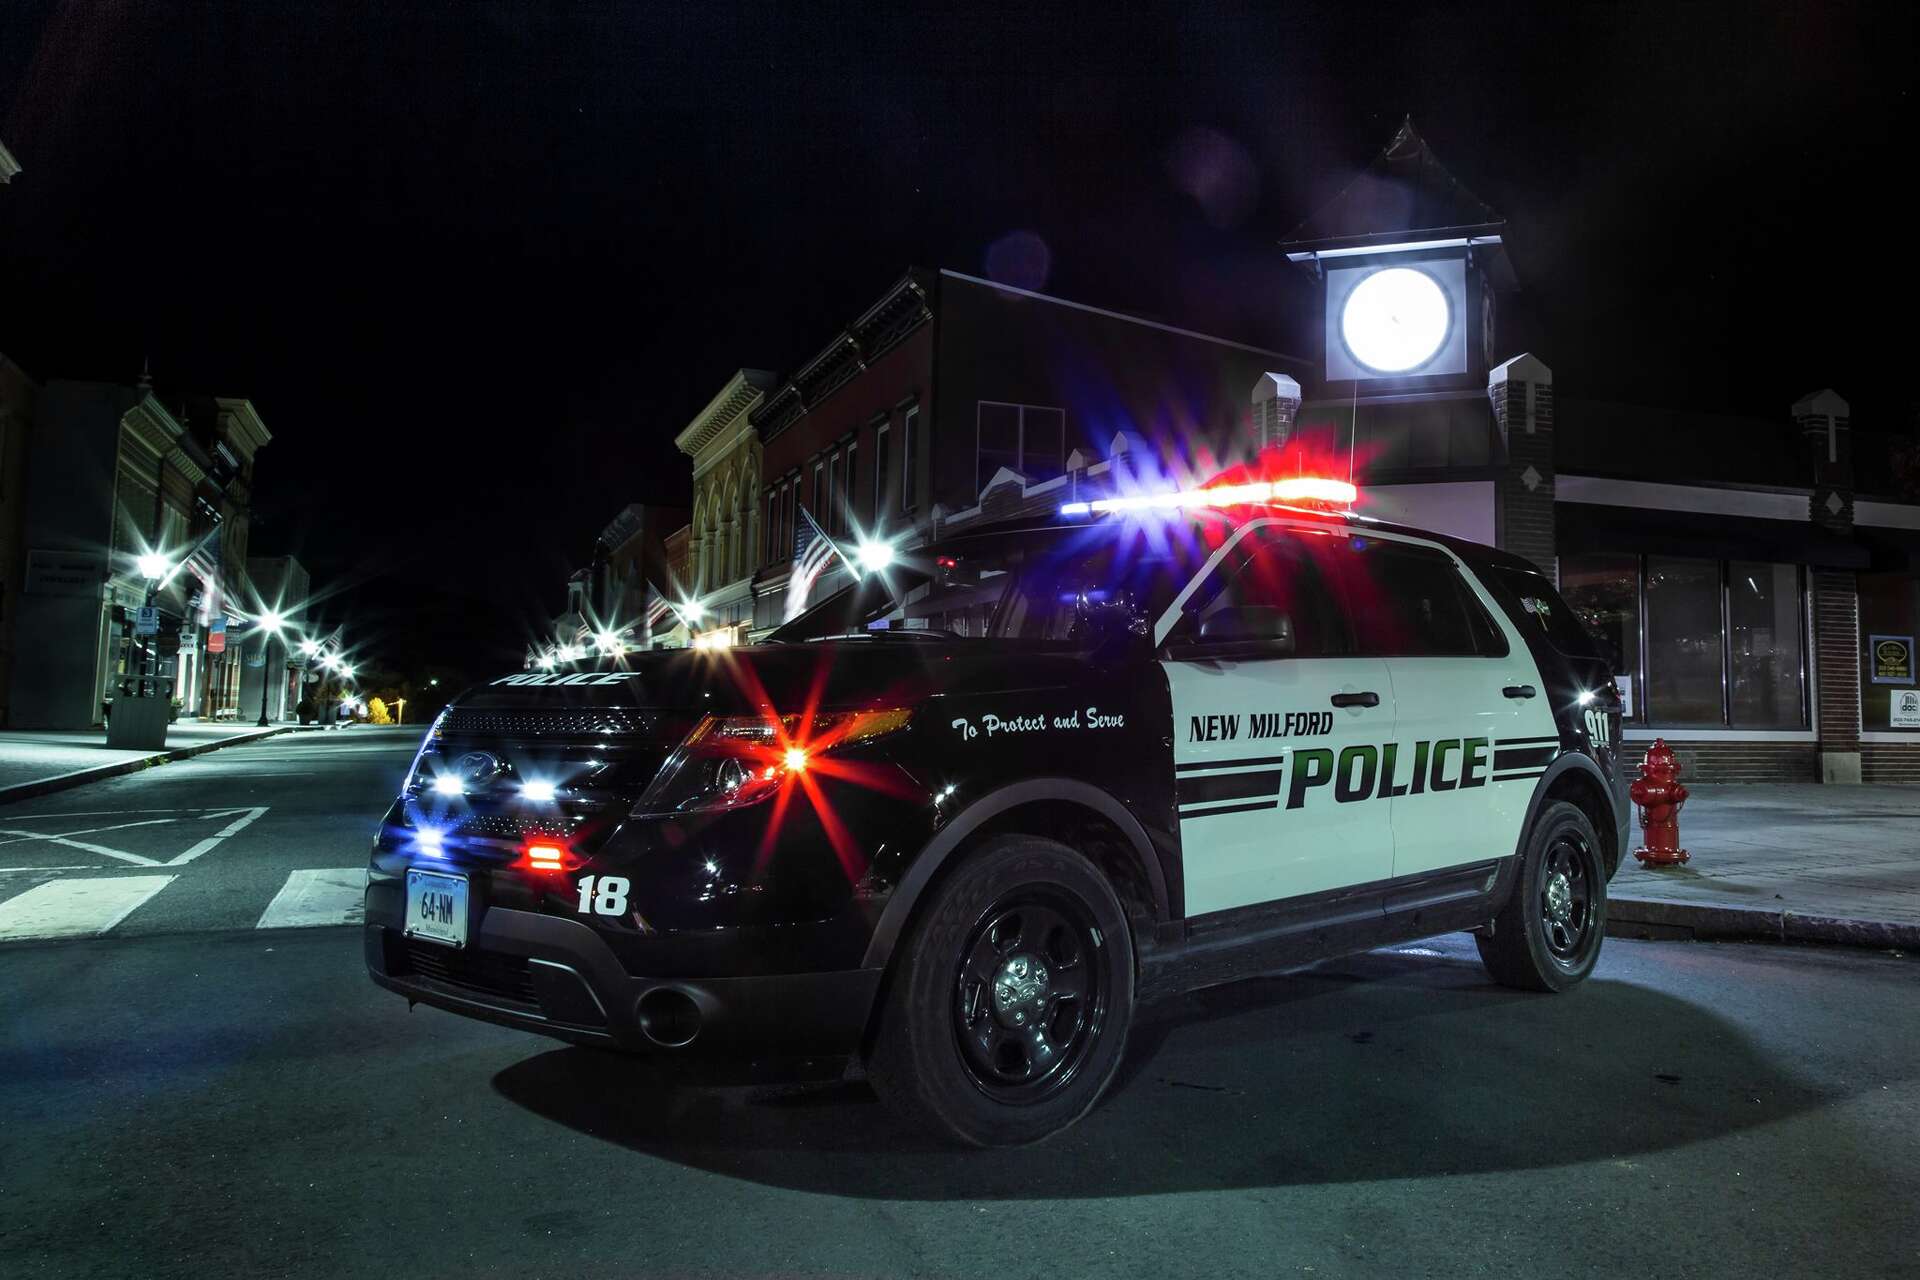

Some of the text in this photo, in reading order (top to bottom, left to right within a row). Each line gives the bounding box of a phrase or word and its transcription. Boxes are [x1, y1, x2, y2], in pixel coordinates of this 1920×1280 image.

[489, 672, 642, 686] POLICE
[952, 707, 1124, 741] To Protect and Serve
[1189, 711, 1334, 742] NEW MILFORD
[1584, 709, 1609, 742] 911
[1285, 737, 1489, 810] POLICE
[577, 875, 630, 916] 18
